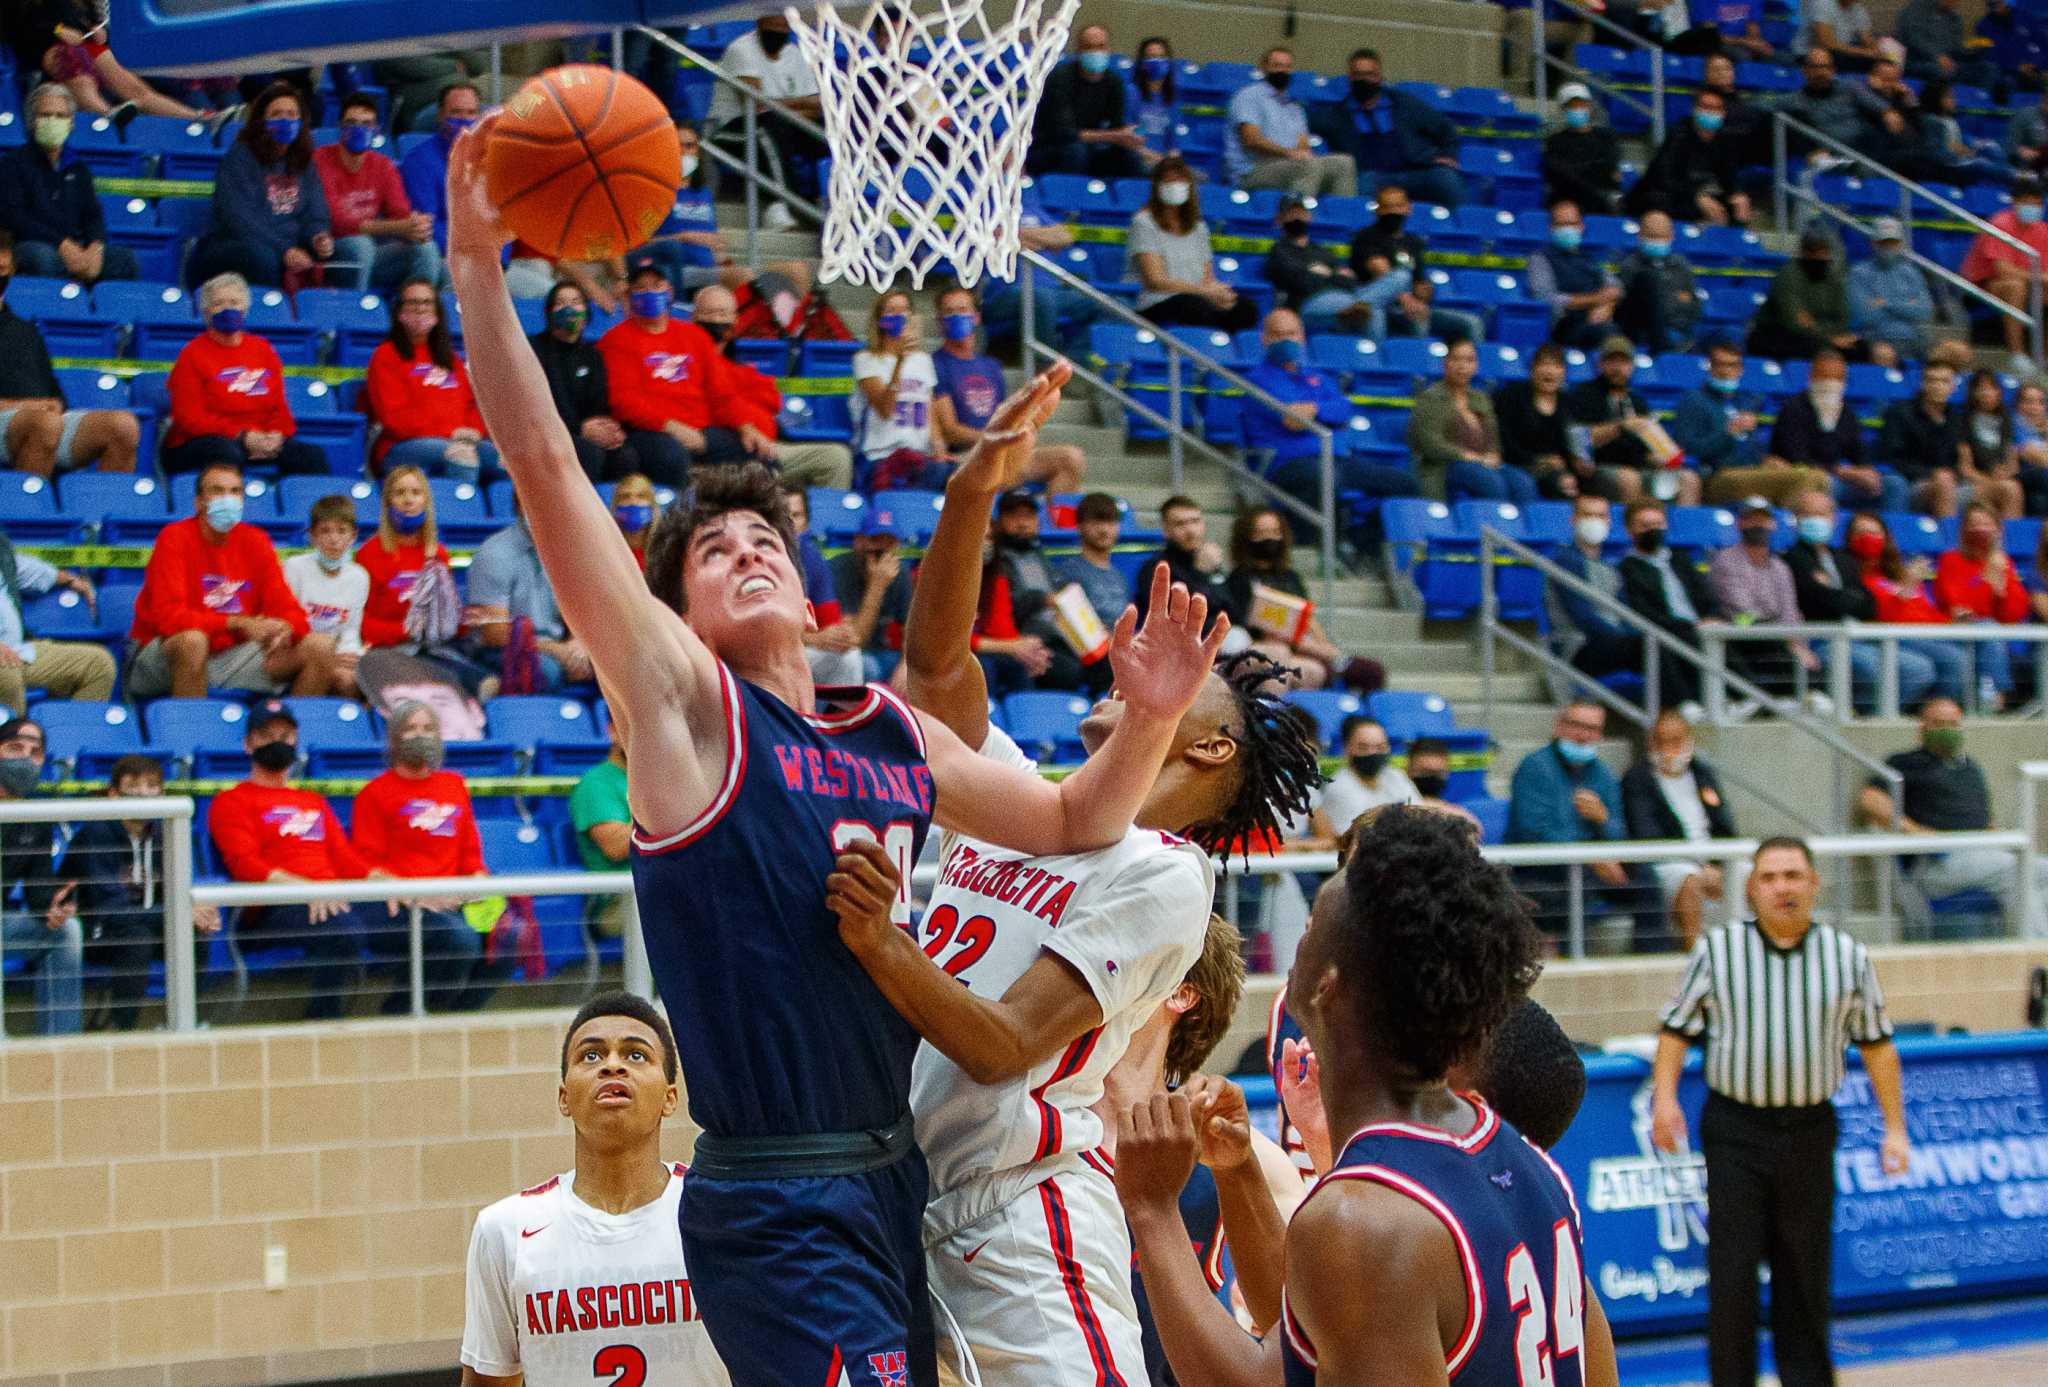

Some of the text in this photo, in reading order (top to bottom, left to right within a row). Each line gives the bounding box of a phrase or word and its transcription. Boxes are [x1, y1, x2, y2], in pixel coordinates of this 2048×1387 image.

[922, 903, 997, 988] 22
[526, 1279, 701, 1335] ATASCOCIT
[1504, 1216, 1586, 1387] 24
